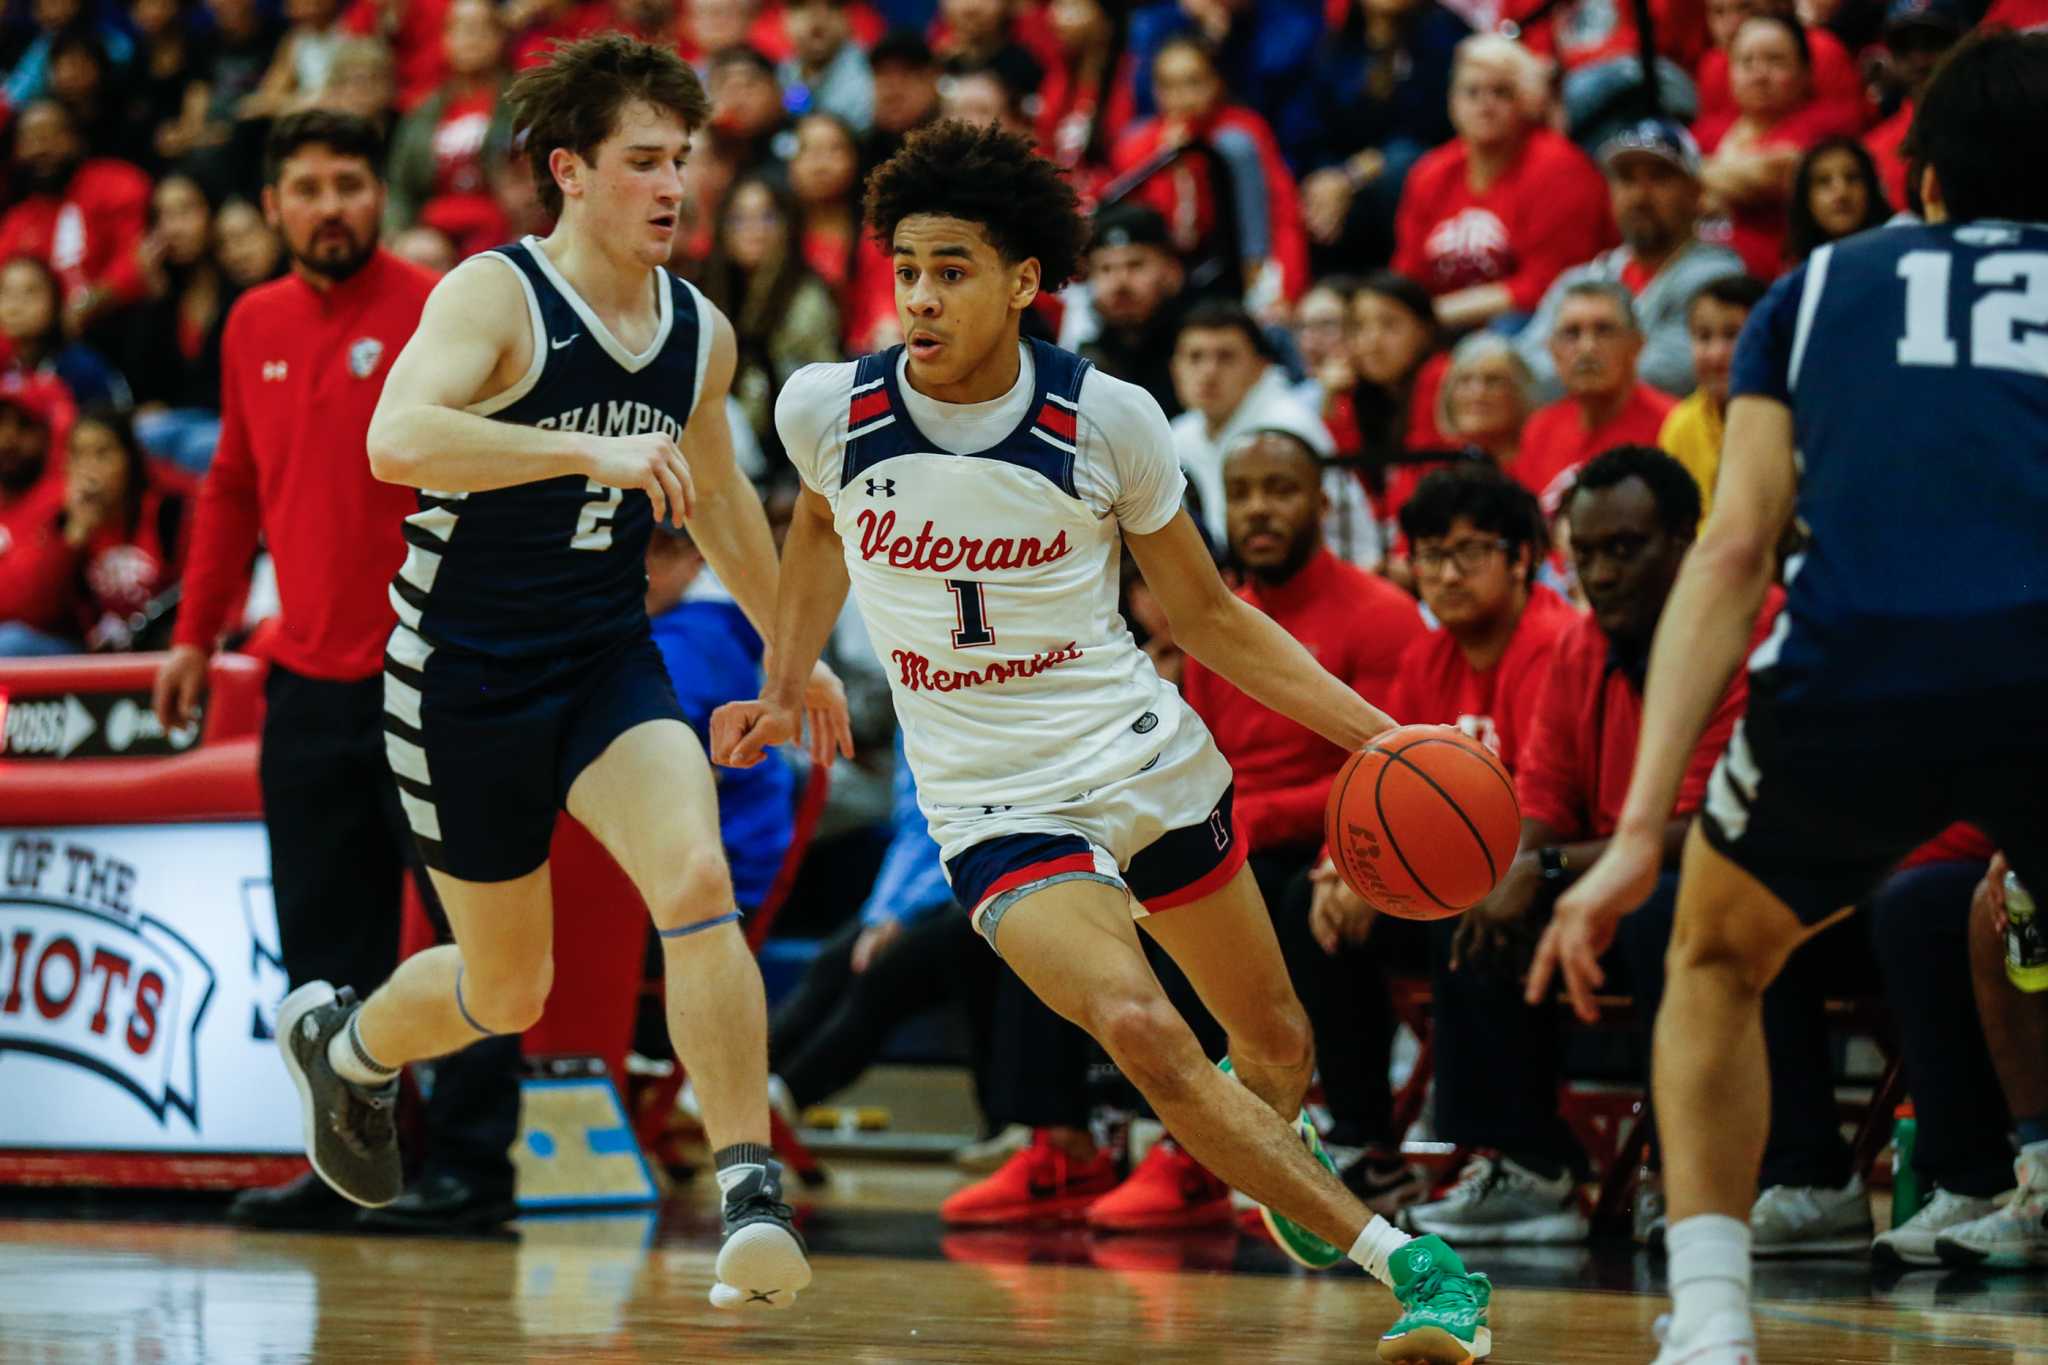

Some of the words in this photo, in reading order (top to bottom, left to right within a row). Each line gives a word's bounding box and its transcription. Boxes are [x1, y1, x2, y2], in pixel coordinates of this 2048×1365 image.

[1896, 250, 2048, 376] 12
[570, 479, 623, 551] 2
[857, 509, 1073, 572] Veterans
[945, 578, 996, 649] 1
[7, 837, 54, 888] OF
[65, 845, 136, 915] THE
[0, 930, 165, 1055] IOTS
